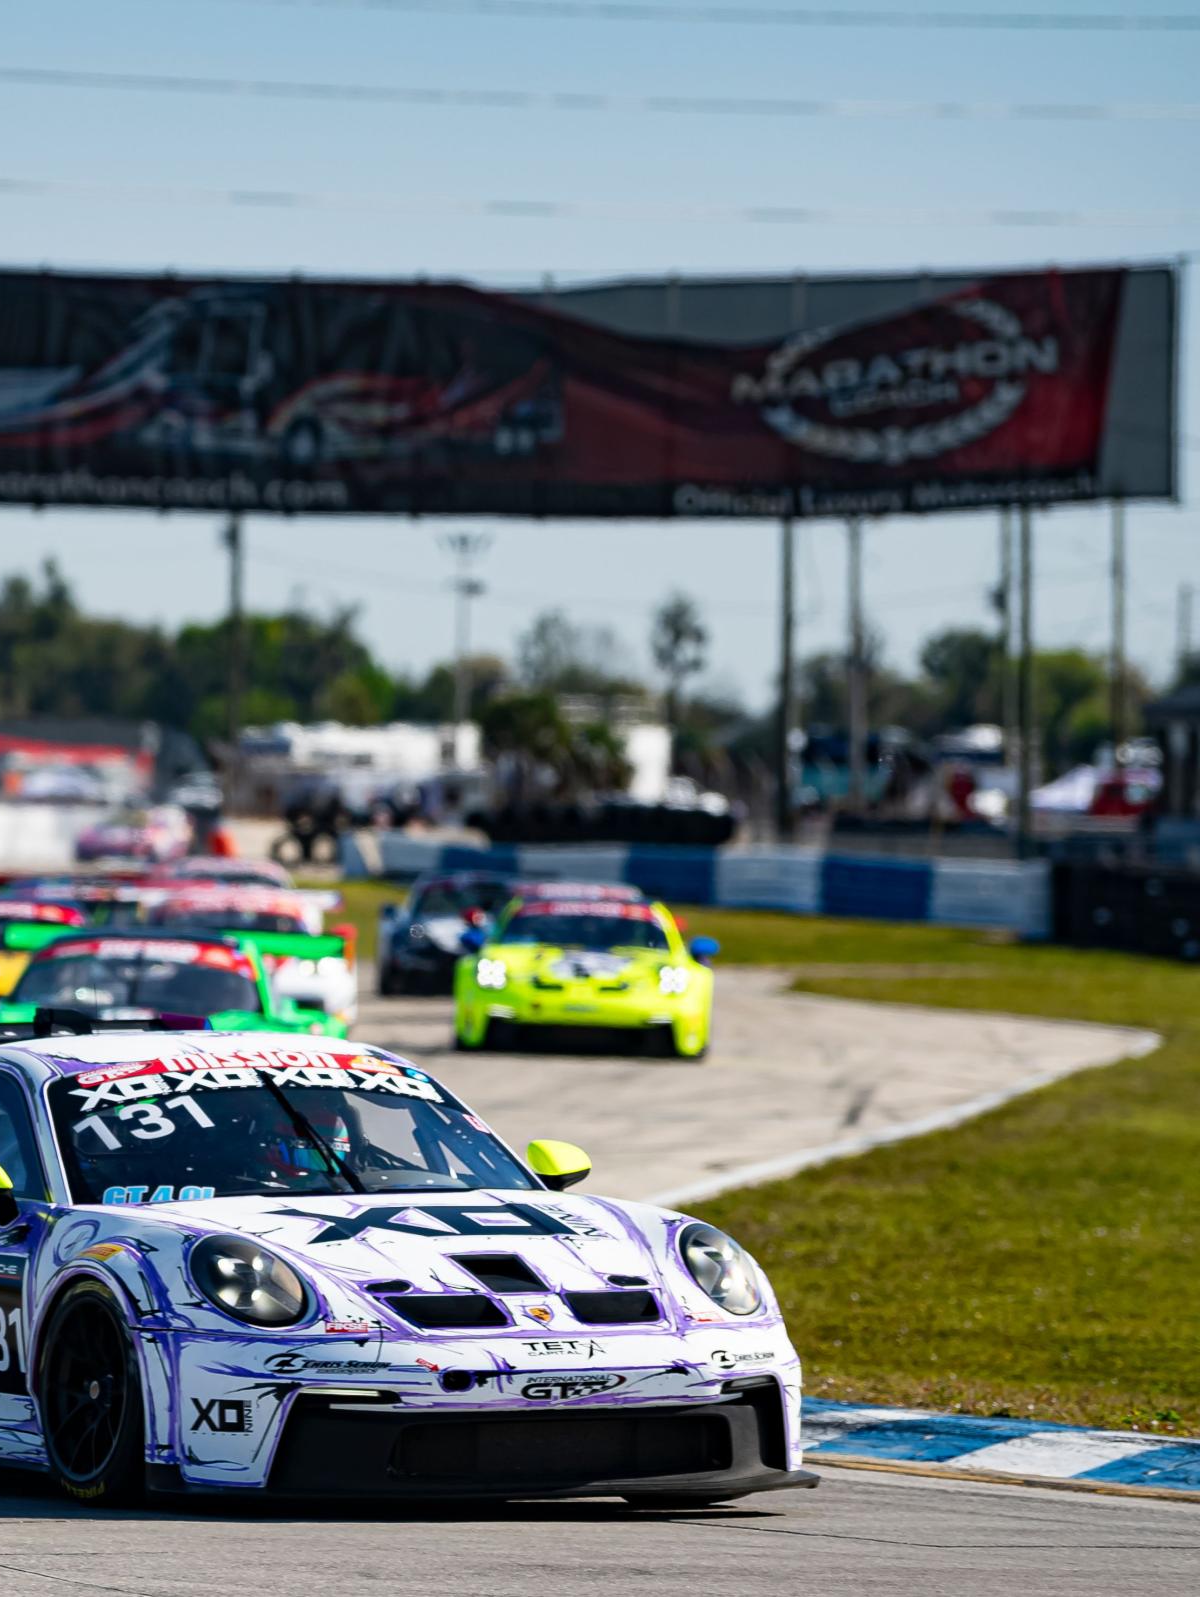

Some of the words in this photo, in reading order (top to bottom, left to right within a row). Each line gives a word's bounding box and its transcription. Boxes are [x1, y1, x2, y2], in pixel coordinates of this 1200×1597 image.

[730, 337, 1058, 403] MARATHON
[158, 1052, 340, 1072] mission
[73, 1095, 216, 1151] 131
[527, 1373, 612, 1384] INTERNATIONAL
[243, 1399, 254, 1433] NINE
